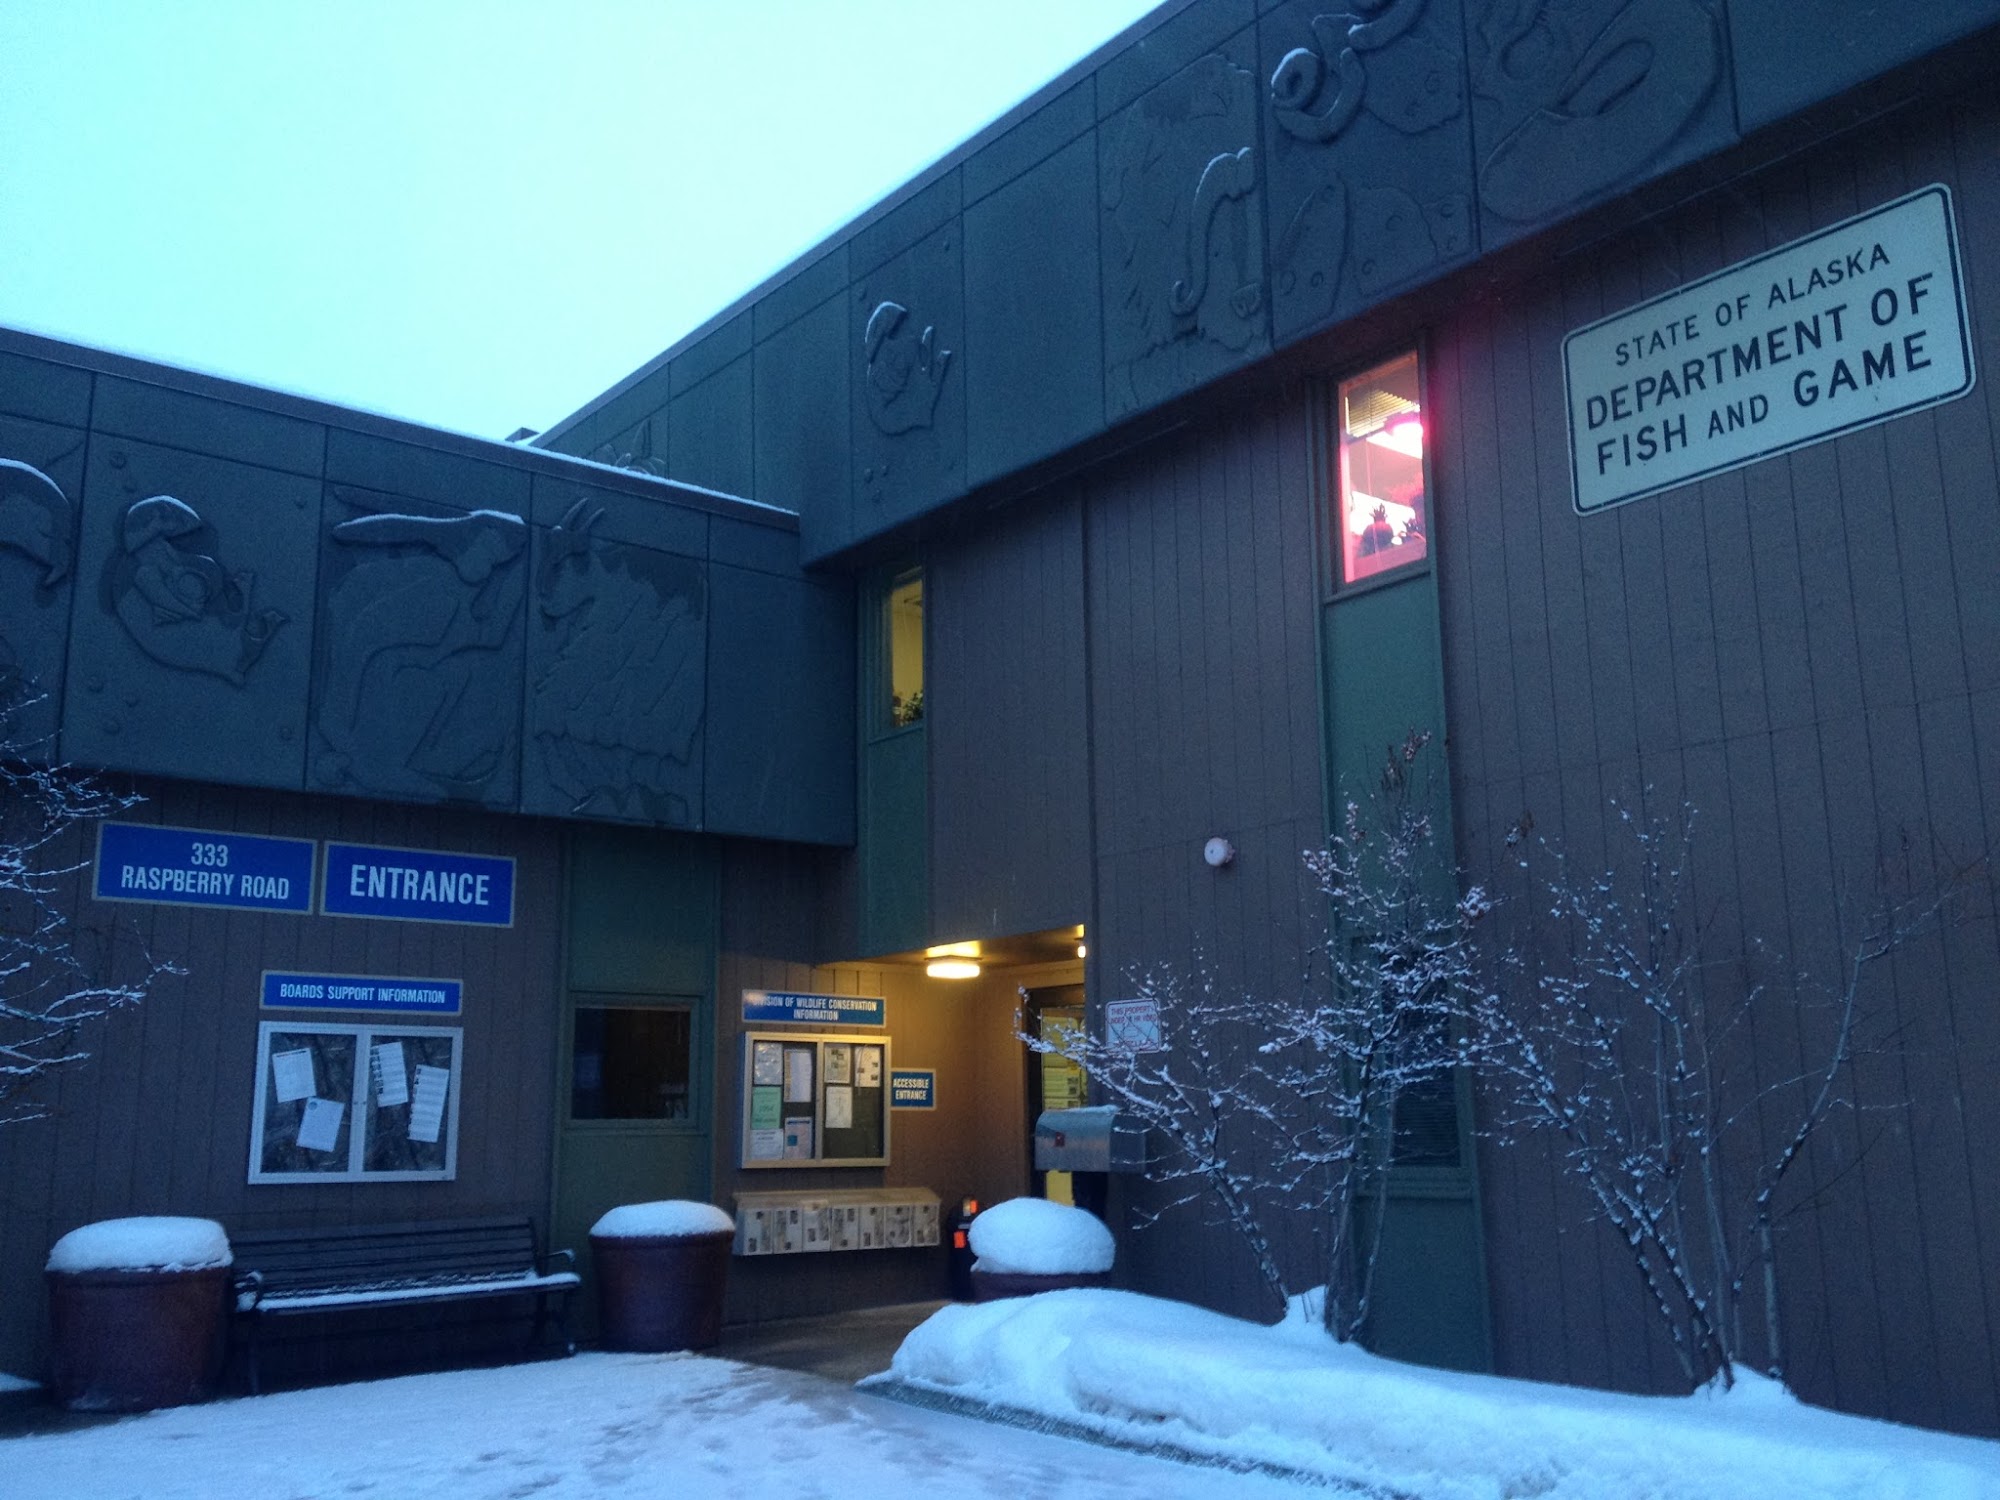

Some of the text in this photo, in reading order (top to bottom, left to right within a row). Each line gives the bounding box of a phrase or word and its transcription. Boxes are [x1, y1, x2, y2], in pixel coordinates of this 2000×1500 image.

[1615, 243, 1890, 366] STATE OF ALASKA
[1586, 272, 1934, 430] DEPARTMENT OF
[1597, 330, 1932, 475] FISH AND GAME
[190, 842, 229, 868] 333
[121, 865, 290, 900] RASPBERRY ROAD
[350, 864, 490, 906] ENTRANCE
[280, 983, 446, 1004] BOARDS SUPPORT INFORMATION
[785, 996, 794, 1008] OF
[796, 997, 826, 1009] WILDLIFE
[828, 999, 877, 1011] CONSERVATION
[793, 1008, 838, 1021] INFORMATION
[893, 1078, 929, 1088] ACCESSIBLE
[895, 1090, 927, 1100] ENTRANCE
